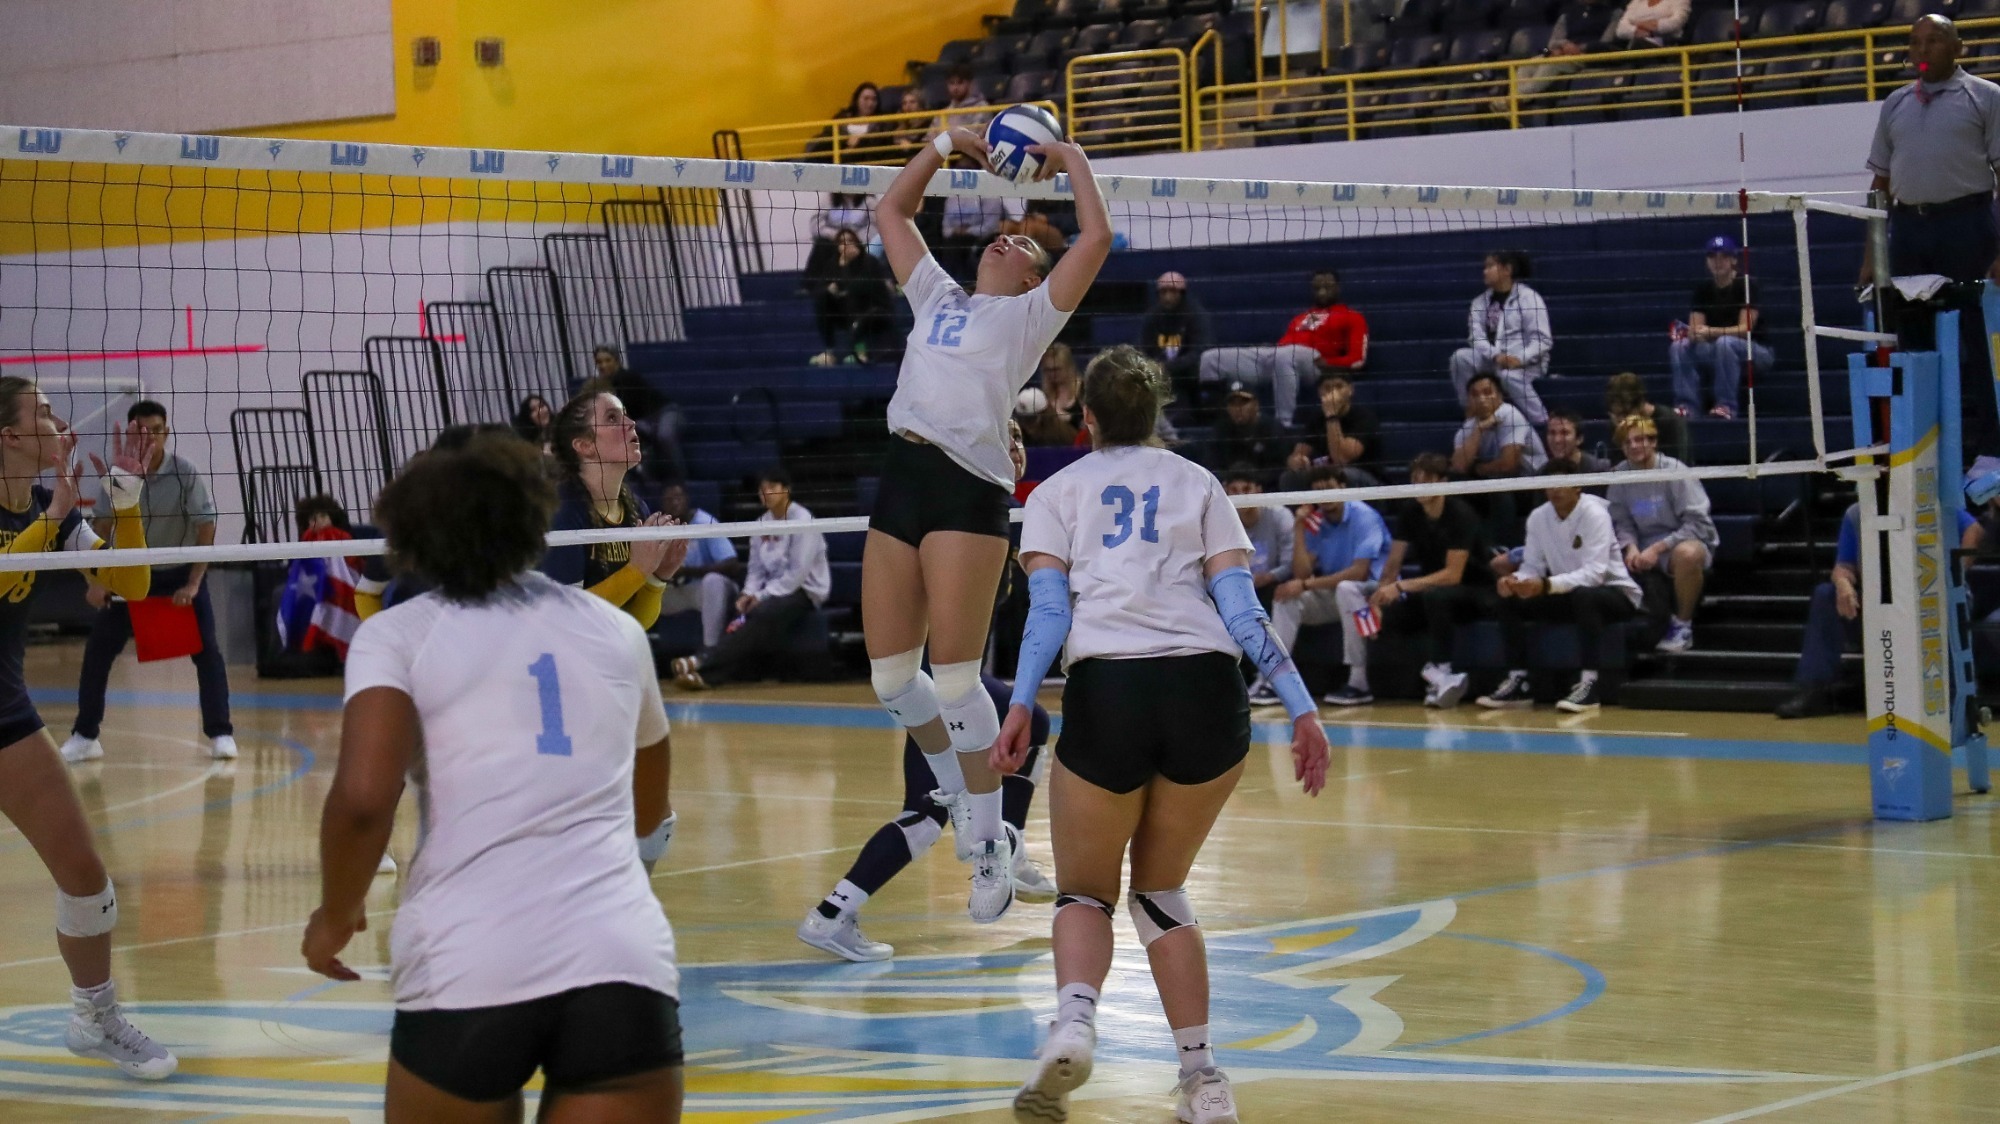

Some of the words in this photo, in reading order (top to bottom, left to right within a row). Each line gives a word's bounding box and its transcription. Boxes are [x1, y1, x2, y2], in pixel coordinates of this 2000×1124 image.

[18, 128, 62, 154] LIU
[180, 135, 220, 160] LIU
[330, 143, 368, 166] LIU
[470, 150, 505, 173] LIU
[601, 156, 634, 178] LIU
[724, 160, 755, 183] LIU
[841, 166, 871, 186] LIU
[951, 170, 978, 189] LIU
[1054, 174, 1074, 193] LI
[1152, 178, 1177, 197] LIU
[1245, 181, 1269, 199] LIU
[1333, 184, 1356, 202] LIU
[1417, 186, 1439, 203] LIU
[926, 313, 968, 347] 12
[1100, 485, 1161, 549] 31
[1916, 467, 1945, 717] SHARKS
[1880, 630, 1896, 679] sports
[527, 652, 573, 757] 1
[1883, 681, 1898, 741] imports
